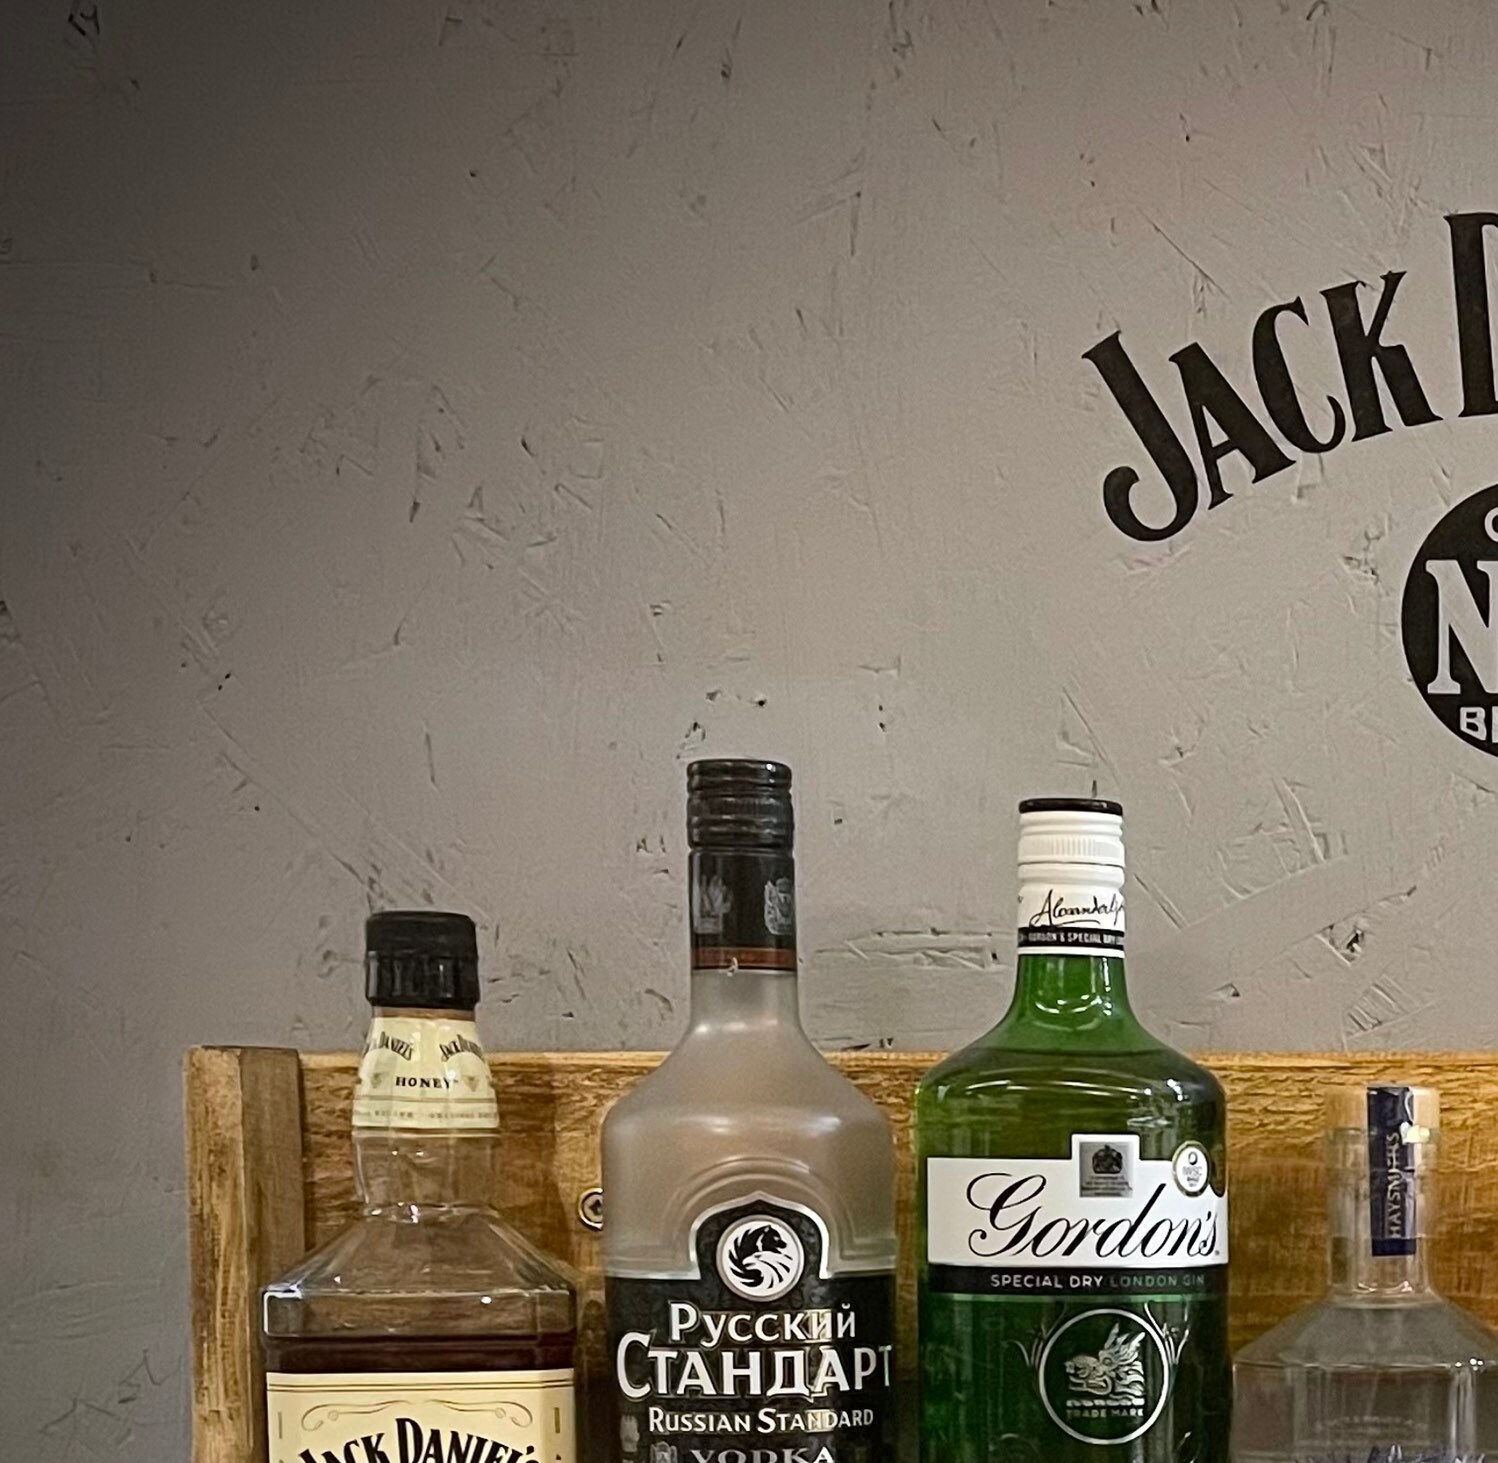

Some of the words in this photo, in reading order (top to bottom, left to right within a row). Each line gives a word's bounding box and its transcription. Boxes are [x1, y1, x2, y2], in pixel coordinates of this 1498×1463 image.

[1081, 270, 1443, 542] JACK
[395, 1076, 450, 1090] HONEY
[966, 1172, 1219, 1258] Gordon's
[990, 1274, 1063, 1288] SPECIAL
[1069, 1274, 1104, 1288] DRY
[1109, 1275, 1177, 1288] LONDON
[1183, 1274, 1205, 1286] GIN
[616, 1331, 892, 1404] СТАНДАРТ
[1066, 1408, 1107, 1418] TRADE
